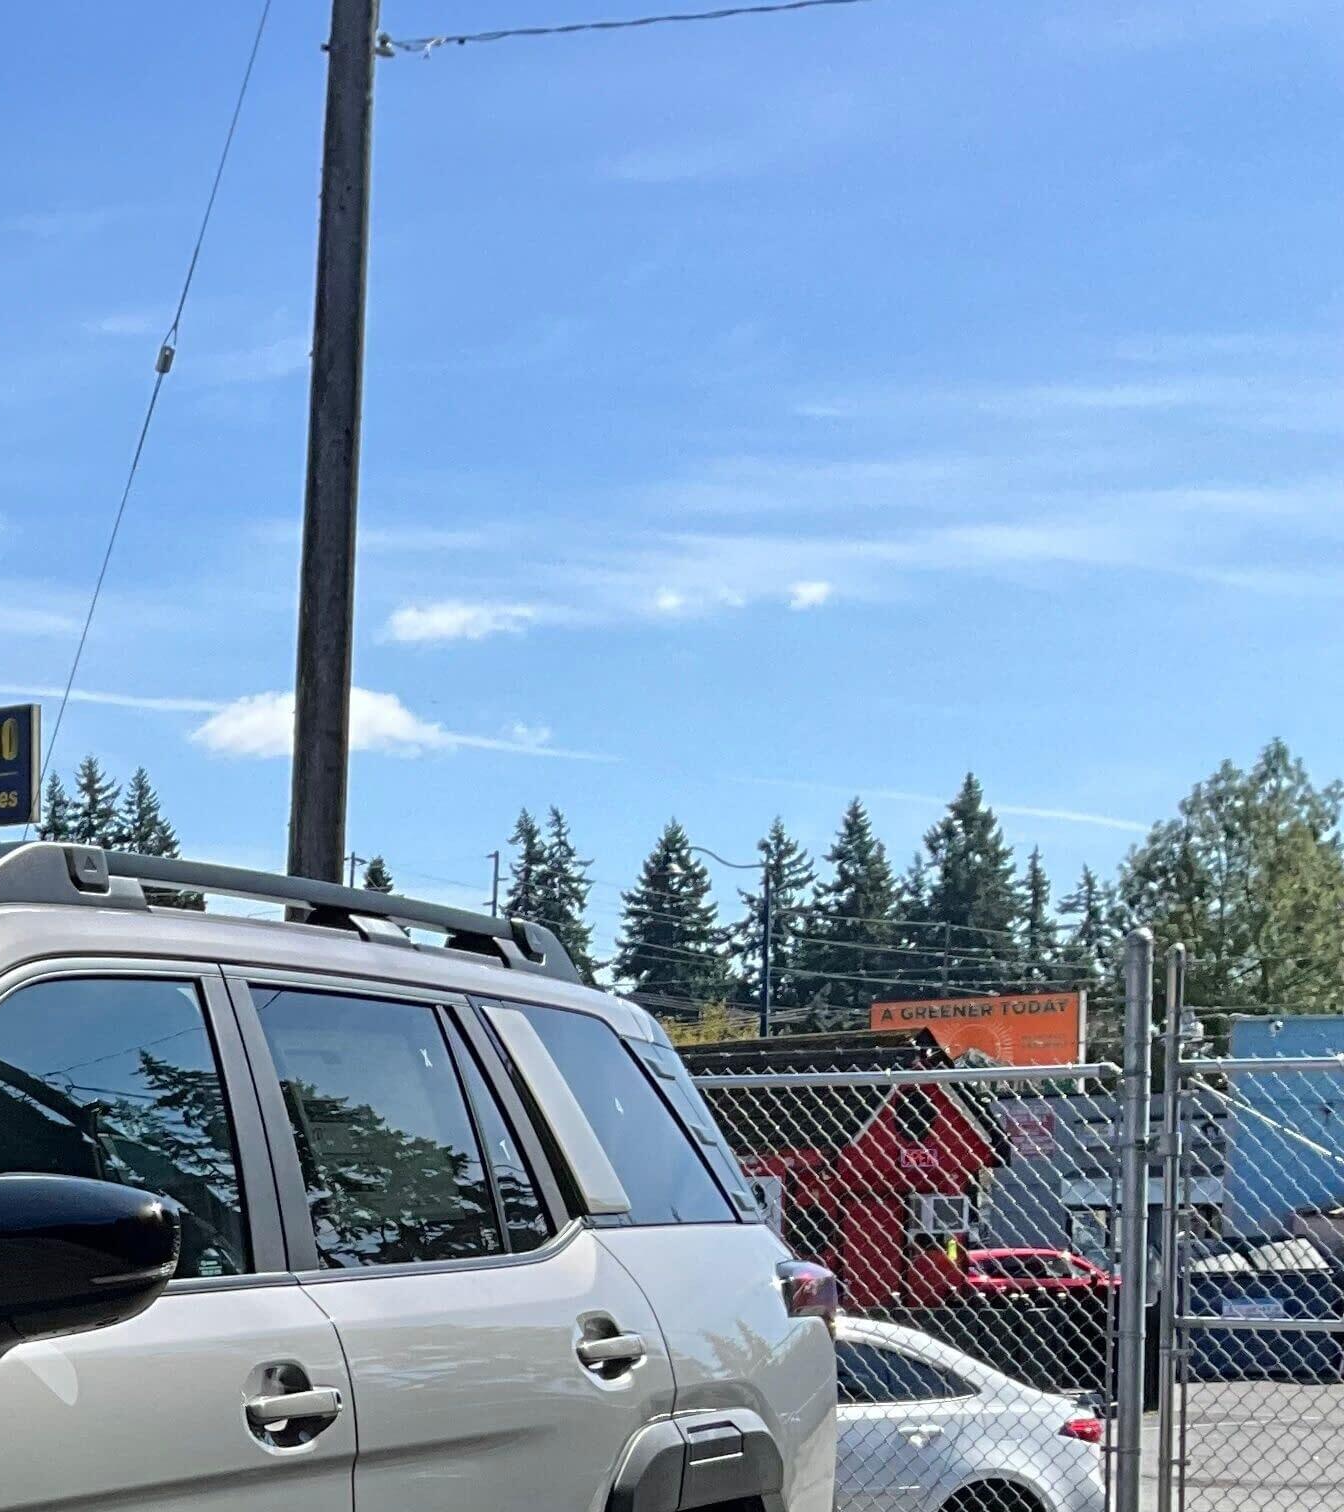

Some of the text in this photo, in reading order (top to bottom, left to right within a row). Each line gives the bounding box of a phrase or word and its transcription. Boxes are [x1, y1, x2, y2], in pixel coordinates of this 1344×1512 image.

[881, 999, 1068, 1022] A GREENER TODAY
